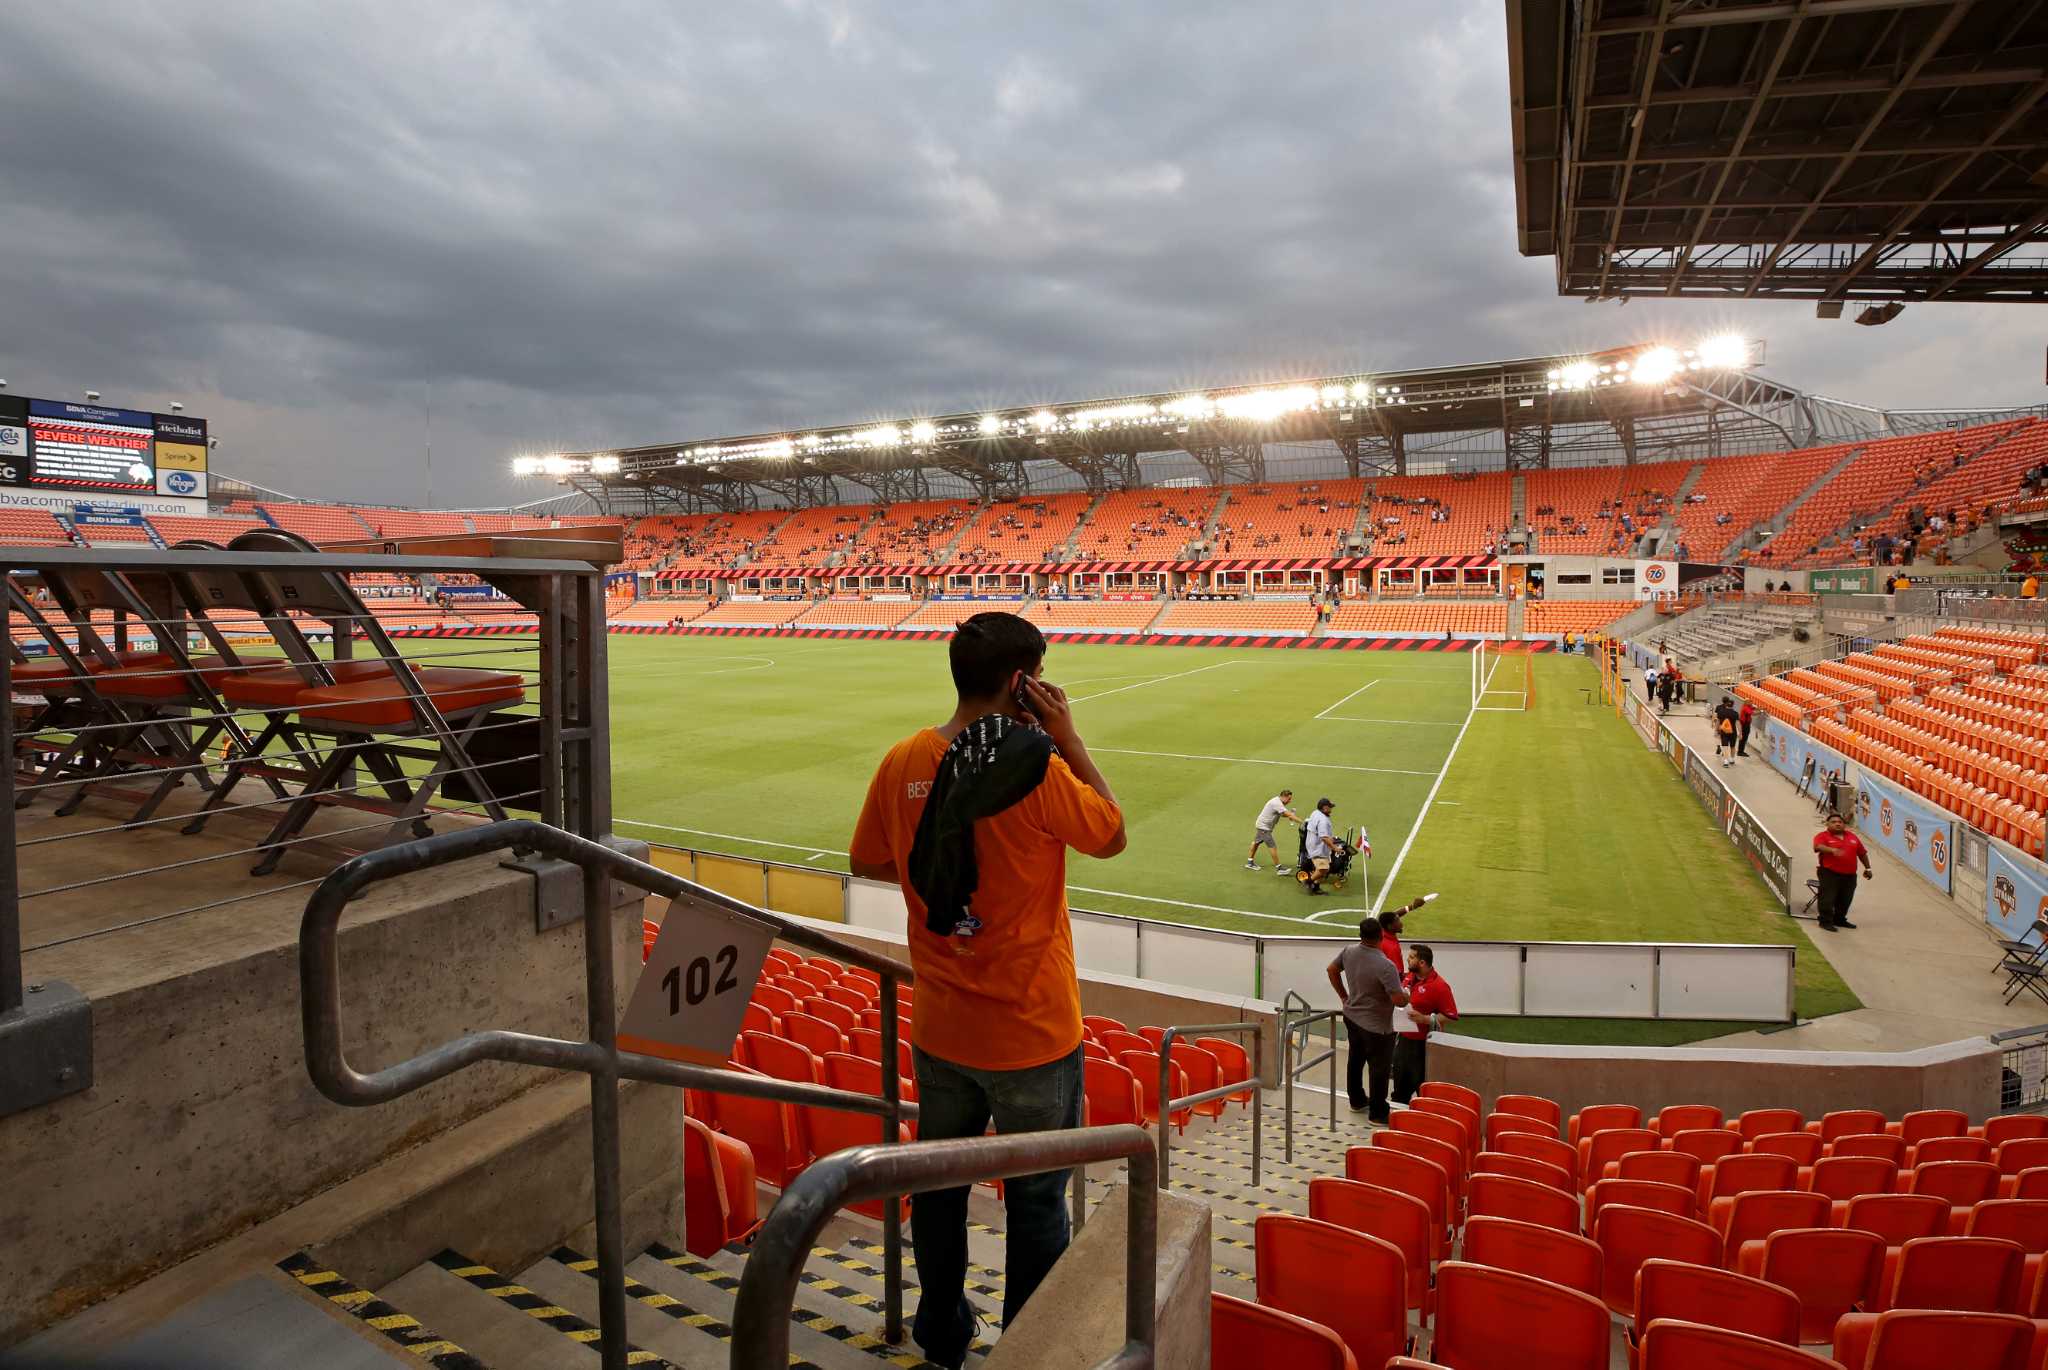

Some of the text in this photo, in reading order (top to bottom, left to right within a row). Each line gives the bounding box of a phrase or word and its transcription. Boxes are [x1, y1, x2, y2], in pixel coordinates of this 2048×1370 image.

[35, 429, 149, 449] SEVERE WEATHER
[158, 424, 202, 436] Methodist
[165, 452, 187, 461] Sprint
[169, 475, 195, 492] Kroger
[86, 515, 104, 523] BUD
[908, 780, 933, 800] BEST
[1934, 841, 1945, 865] 76
[662, 944, 738, 1017] 102
